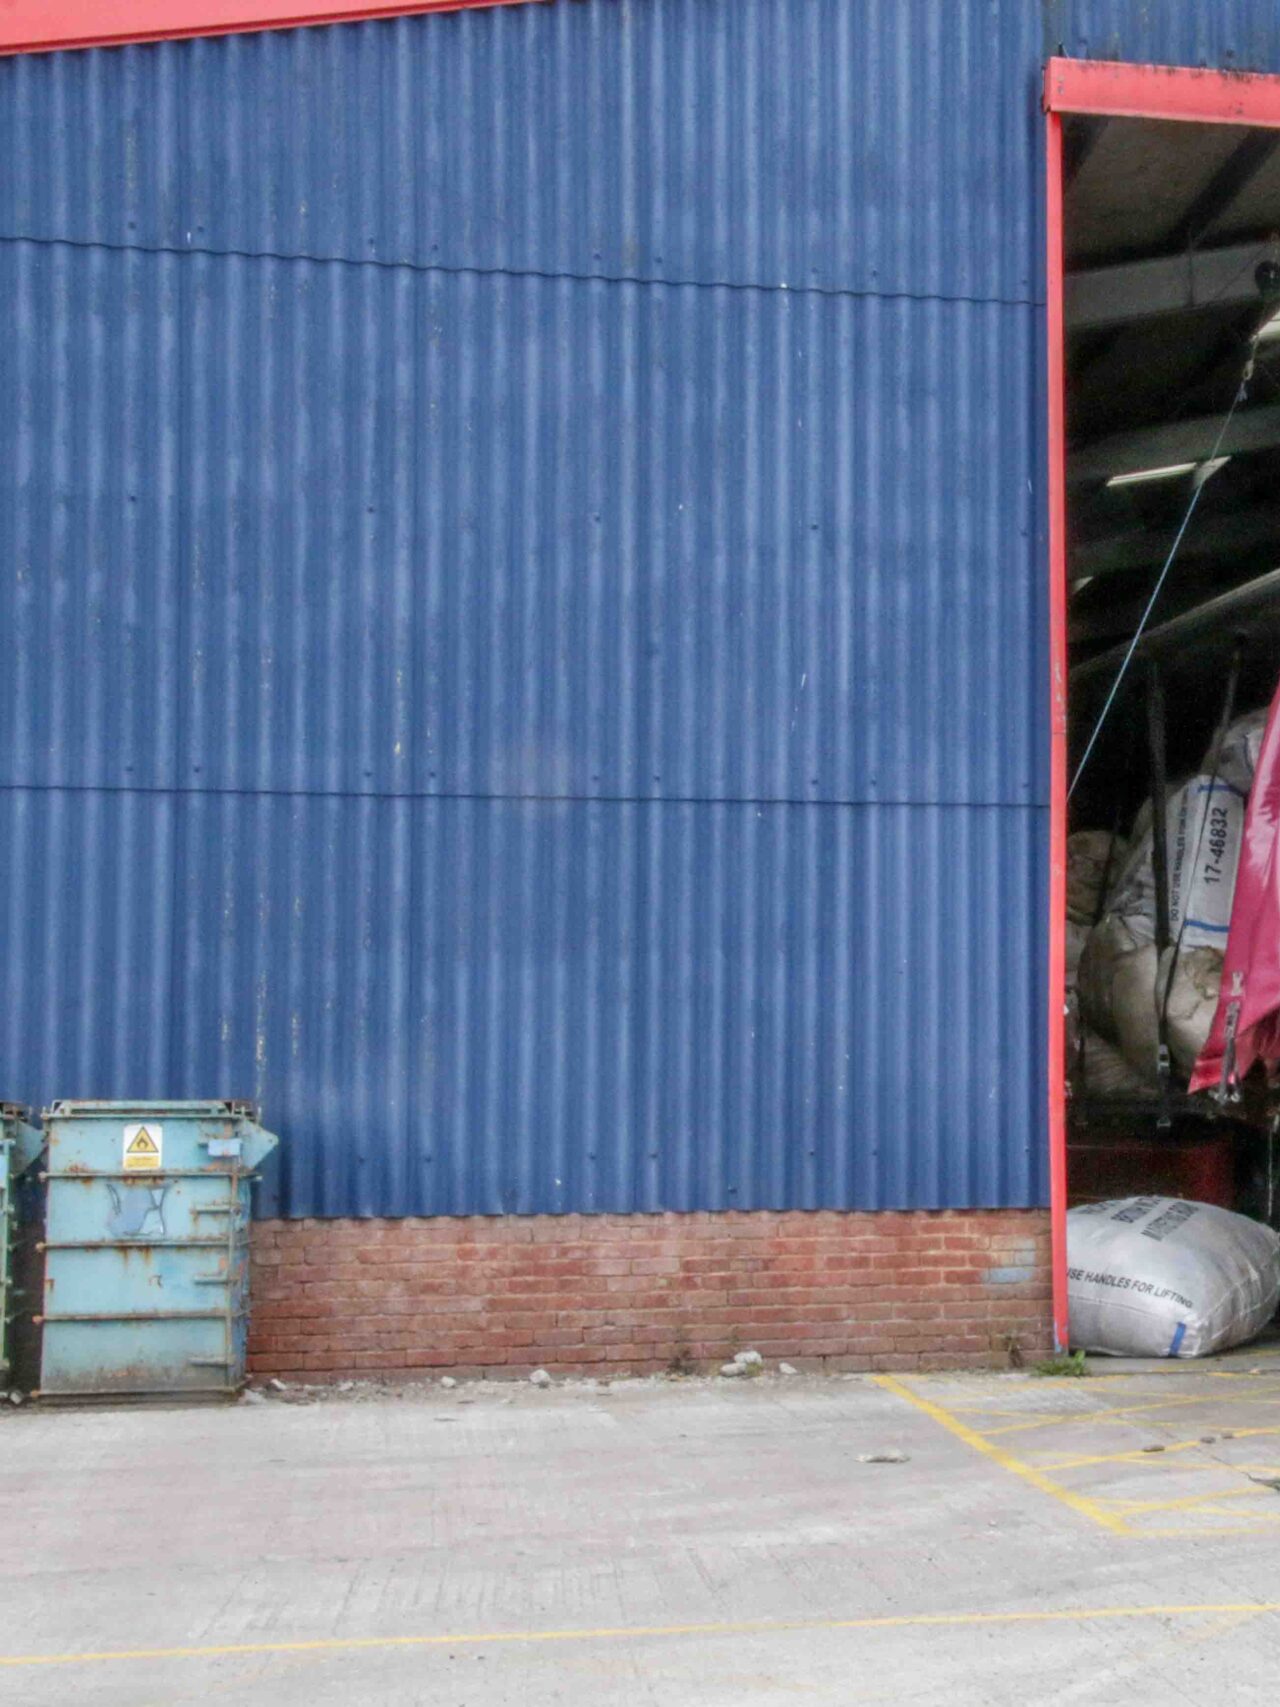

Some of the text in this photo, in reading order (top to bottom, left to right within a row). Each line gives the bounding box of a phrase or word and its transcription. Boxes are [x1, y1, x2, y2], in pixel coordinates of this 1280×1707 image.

[1203, 807, 1228, 885] 17-46832
[1084, 1271, 1131, 1289] HANDLES
[1130, 1280, 1155, 1295] FOR
[1153, 1287, 1194, 1309] LIFTING
